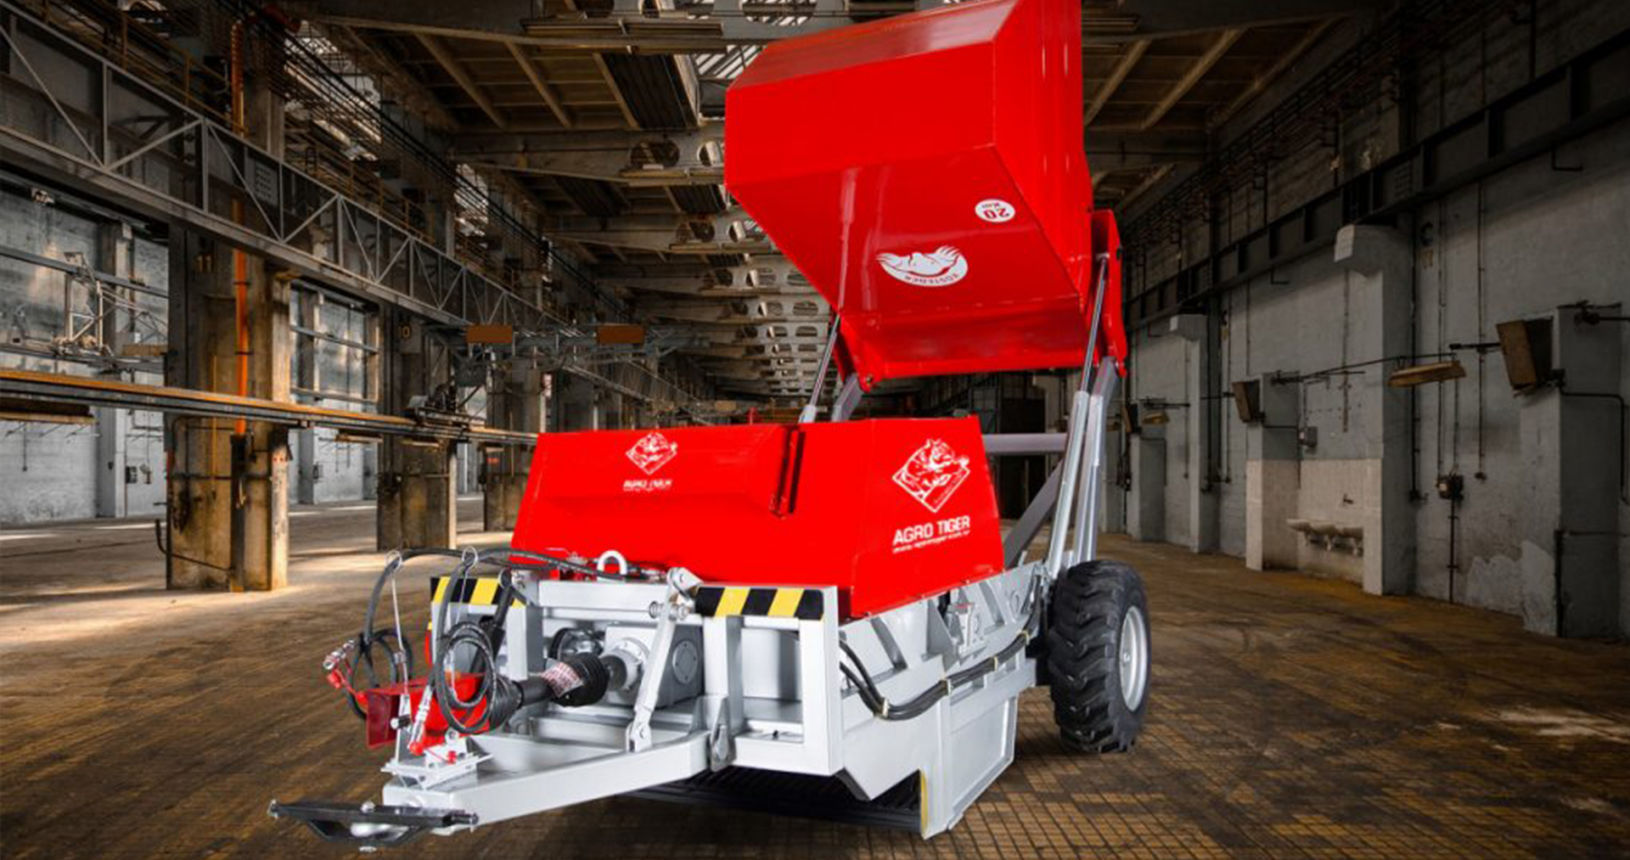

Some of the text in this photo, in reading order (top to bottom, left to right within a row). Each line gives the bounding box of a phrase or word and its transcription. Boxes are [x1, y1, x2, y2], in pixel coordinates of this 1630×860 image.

[983, 208, 1010, 220] 20
[892, 515, 971, 546] AGRO TIGER
